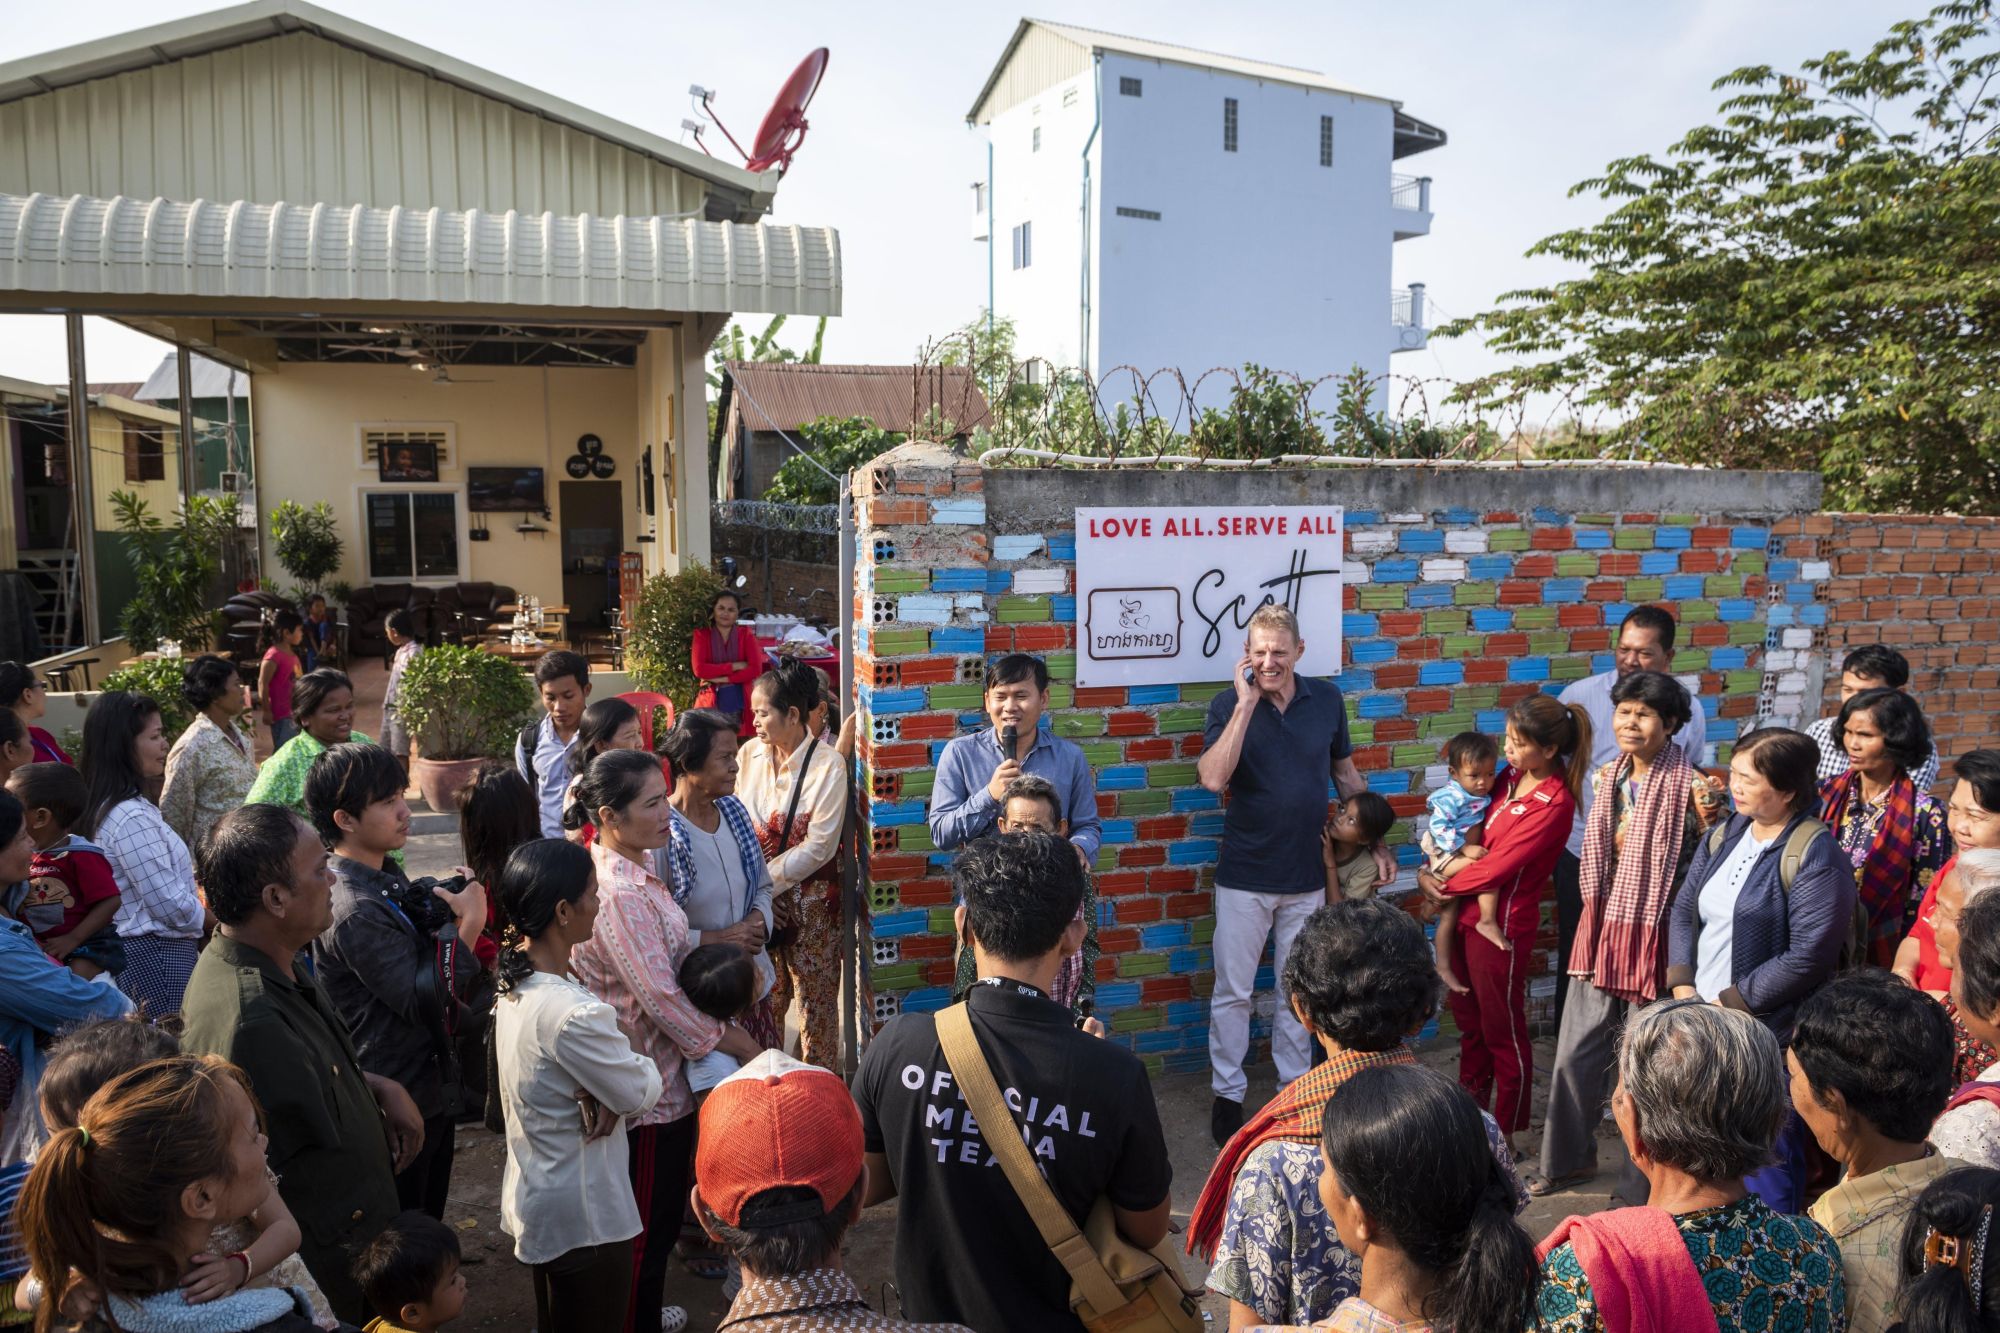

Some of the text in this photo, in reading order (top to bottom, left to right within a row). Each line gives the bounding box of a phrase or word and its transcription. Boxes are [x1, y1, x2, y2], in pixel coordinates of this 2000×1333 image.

[1089, 518, 1151, 538] LOVE
[1298, 516, 1336, 535] ALL
[901, 1064, 1096, 1138] OFCIAL
[931, 1138, 1048, 1179] TE
